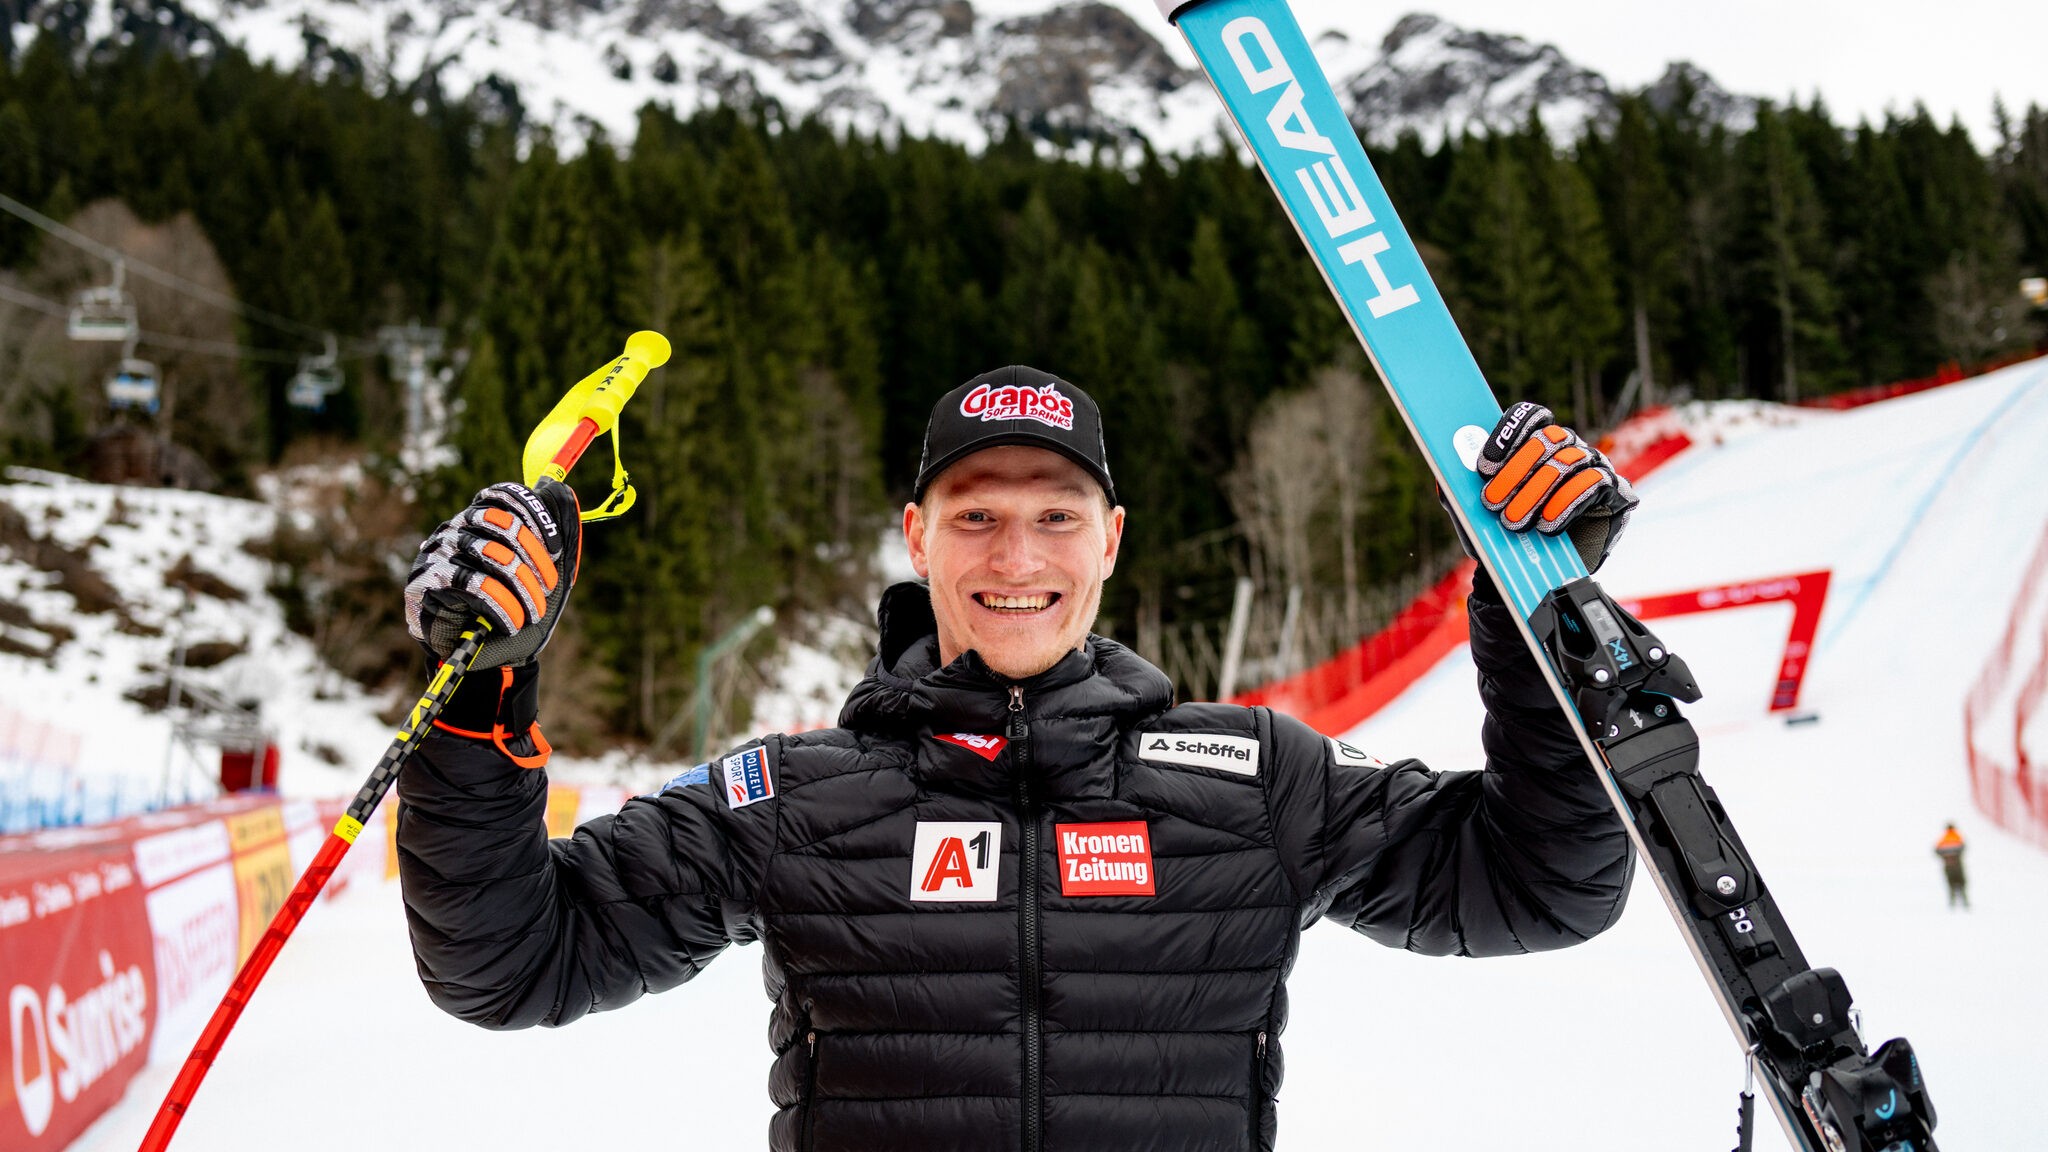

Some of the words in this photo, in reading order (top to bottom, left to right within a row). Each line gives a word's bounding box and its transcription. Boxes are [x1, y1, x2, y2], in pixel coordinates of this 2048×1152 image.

[1221, 16, 1420, 319] HEAD
[596, 356, 630, 391] LEKI
[985, 407, 1018, 419] SOFT
[1028, 407, 1071, 428] DRINKS
[1495, 402, 1536, 450] reusc
[1608, 639, 1633, 671] 14X
[730, 757, 744, 782] SPORT
[745, 752, 762, 790] POLIZEI
[1062, 831, 1146, 856] Kronen
[920, 830, 991, 892] A1
[1064, 858, 1149, 886] Zeitung
